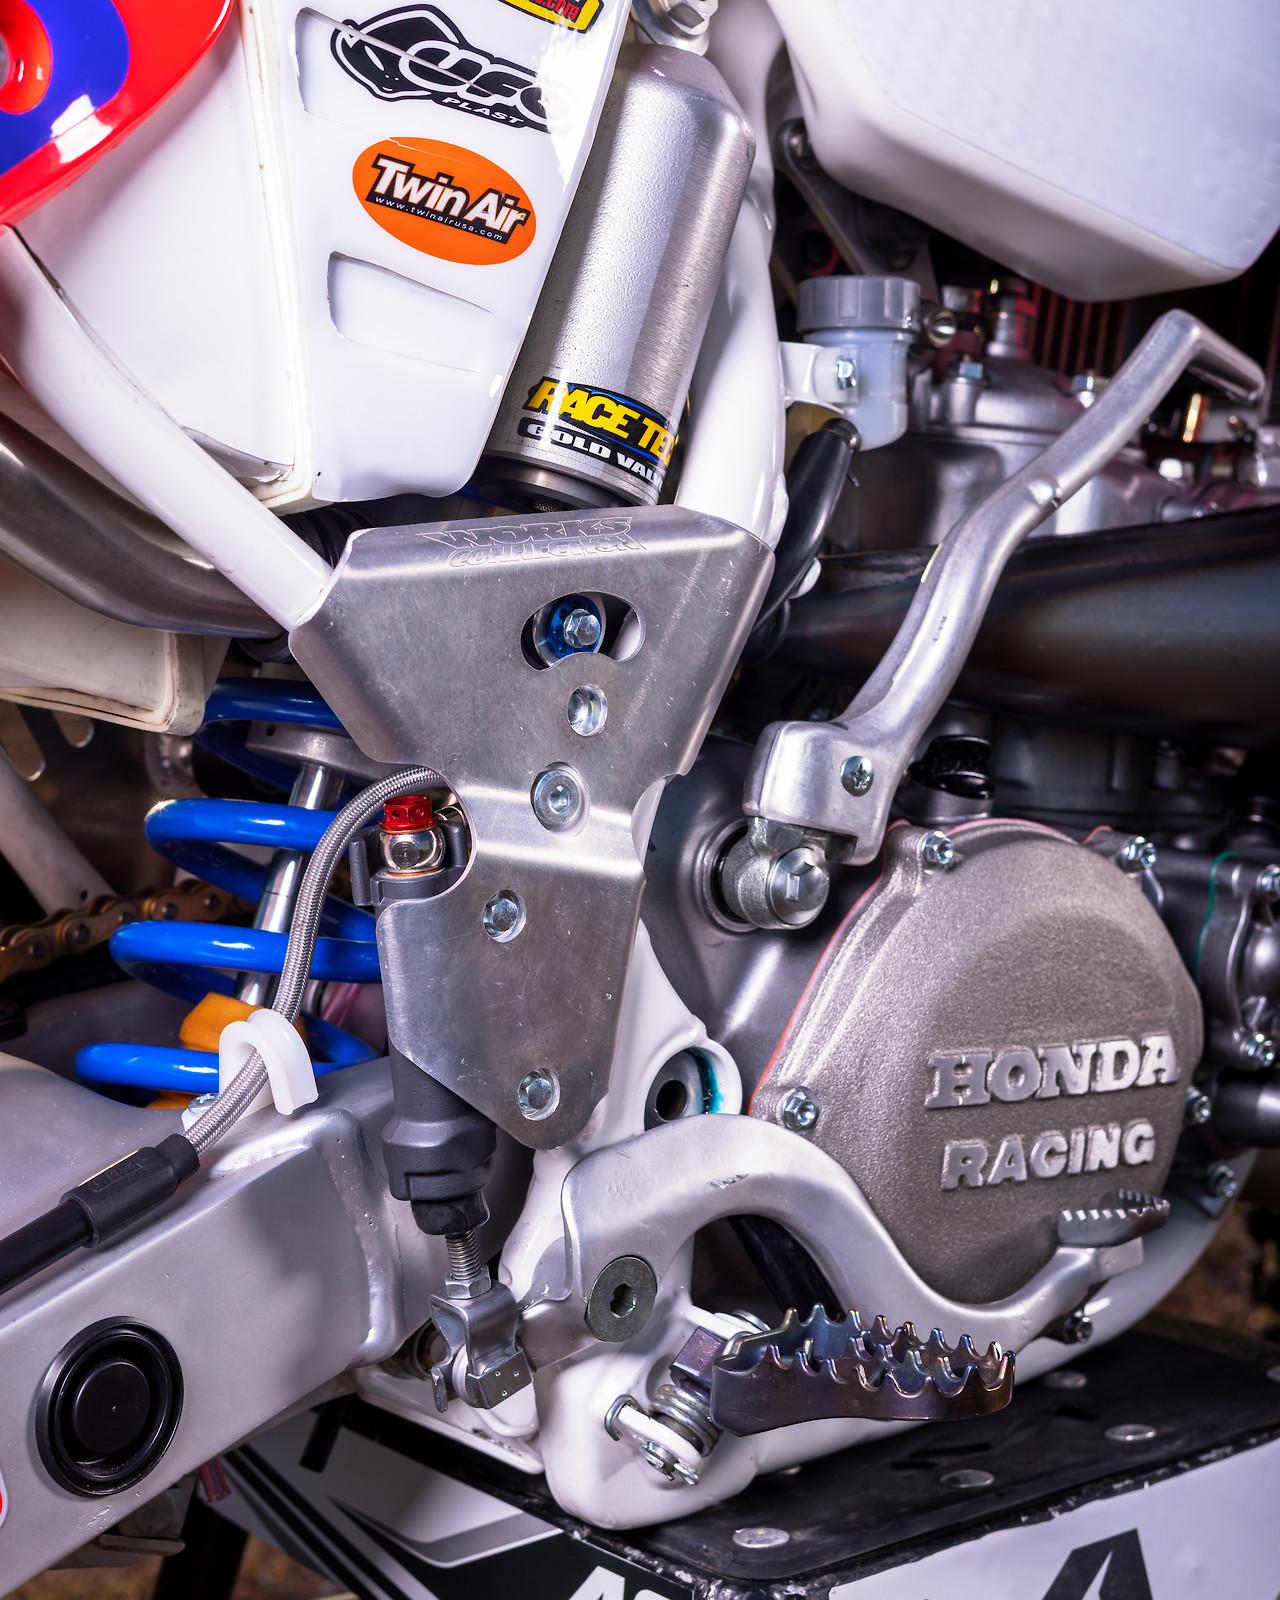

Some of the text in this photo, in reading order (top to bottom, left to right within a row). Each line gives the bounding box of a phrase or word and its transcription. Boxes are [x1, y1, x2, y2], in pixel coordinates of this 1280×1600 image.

[442, 97, 524, 124] PLAST
[374, 157, 527, 234] Twin Air
[375, 196, 503, 241] www.twinairusa.com
[527, 380, 641, 439] RACE
[526, 423, 612, 459] GOLD
[415, 516, 633, 549] WORKS
[925, 1033, 1180, 1109] HONDA
[941, 1120, 1156, 1190] RACING
